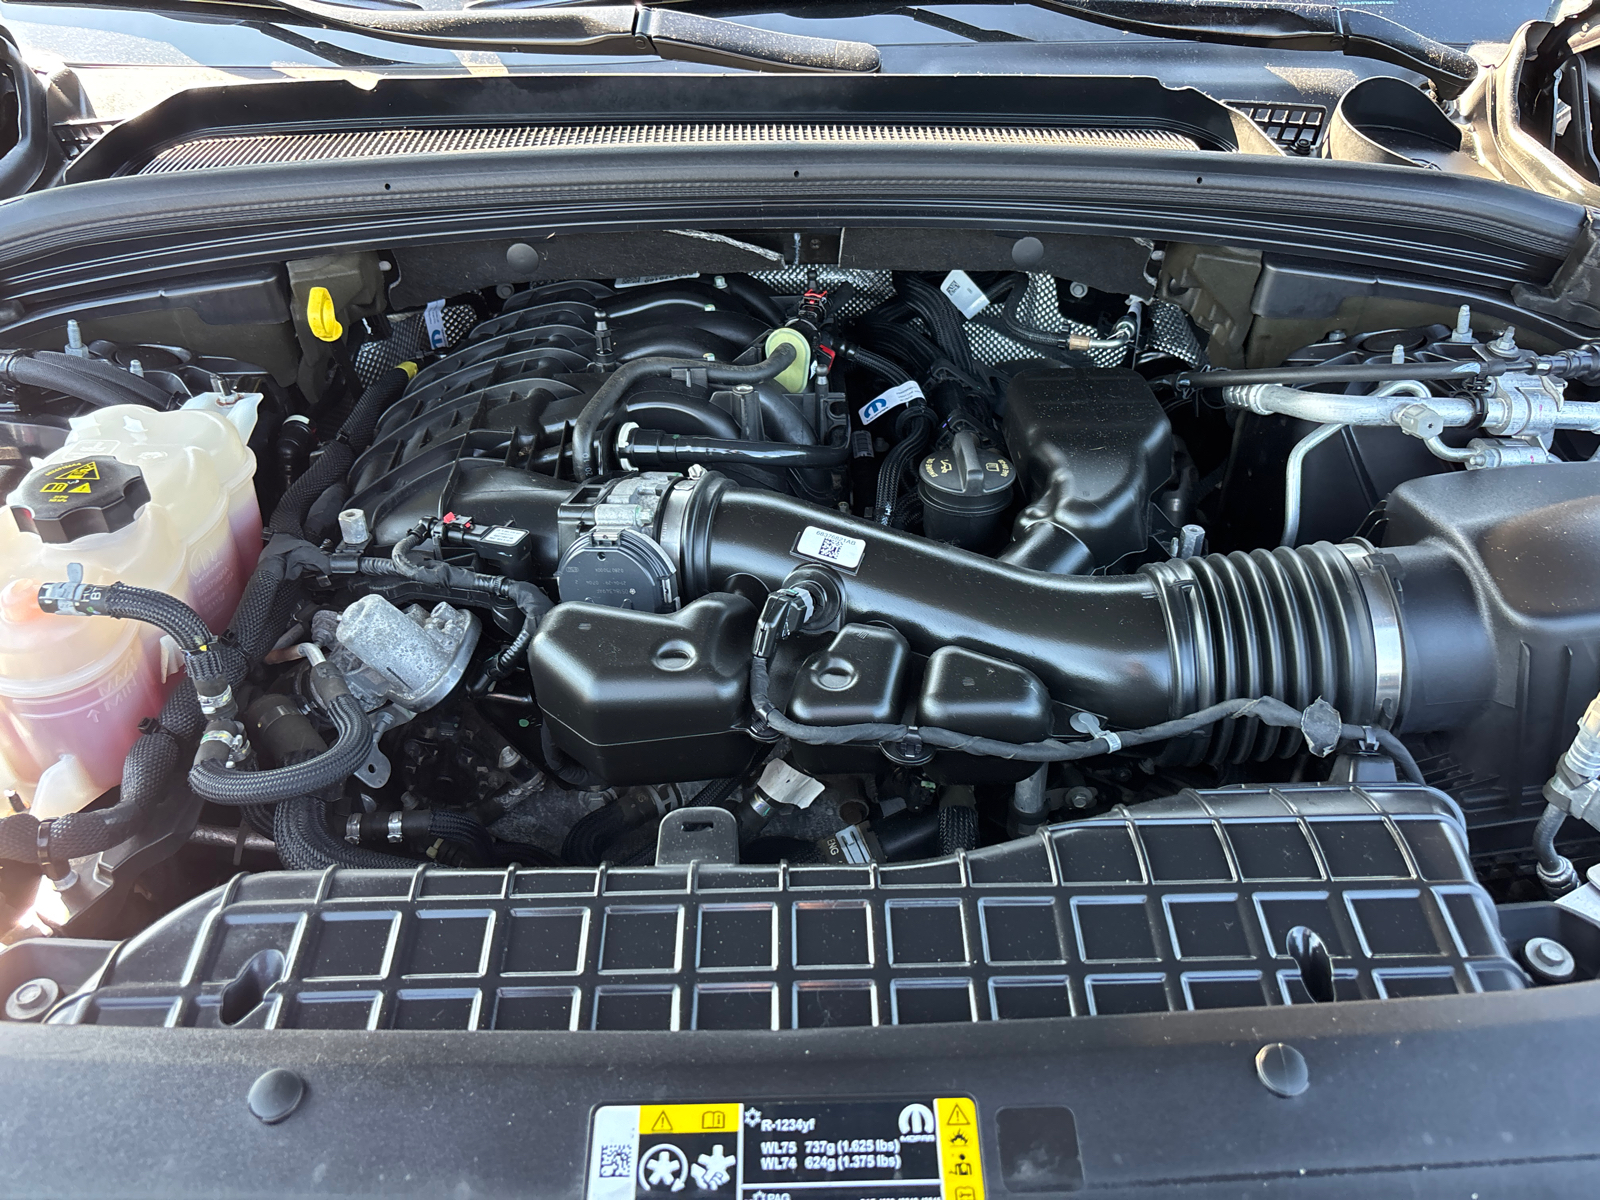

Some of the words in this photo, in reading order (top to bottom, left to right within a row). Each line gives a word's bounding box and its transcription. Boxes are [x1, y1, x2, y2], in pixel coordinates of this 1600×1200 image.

[925, 463, 938, 478] ENGINE
[827, 839, 839, 855] ENG
[760, 1118, 816, 1133] R-1234yf
[899, 1134, 936, 1143] MOPAR
[760, 1141, 797, 1155] WL75
[804, 1140, 836, 1156] 737g
[837, 1139, 874, 1155] (1.625
[876, 1138, 901, 1154] lbs)
[760, 1157, 797, 1171] WL74
[804, 1156, 836, 1172] 624g
[837, 1155, 875, 1171] (1.375
[876, 1154, 902, 1170] lbs)
